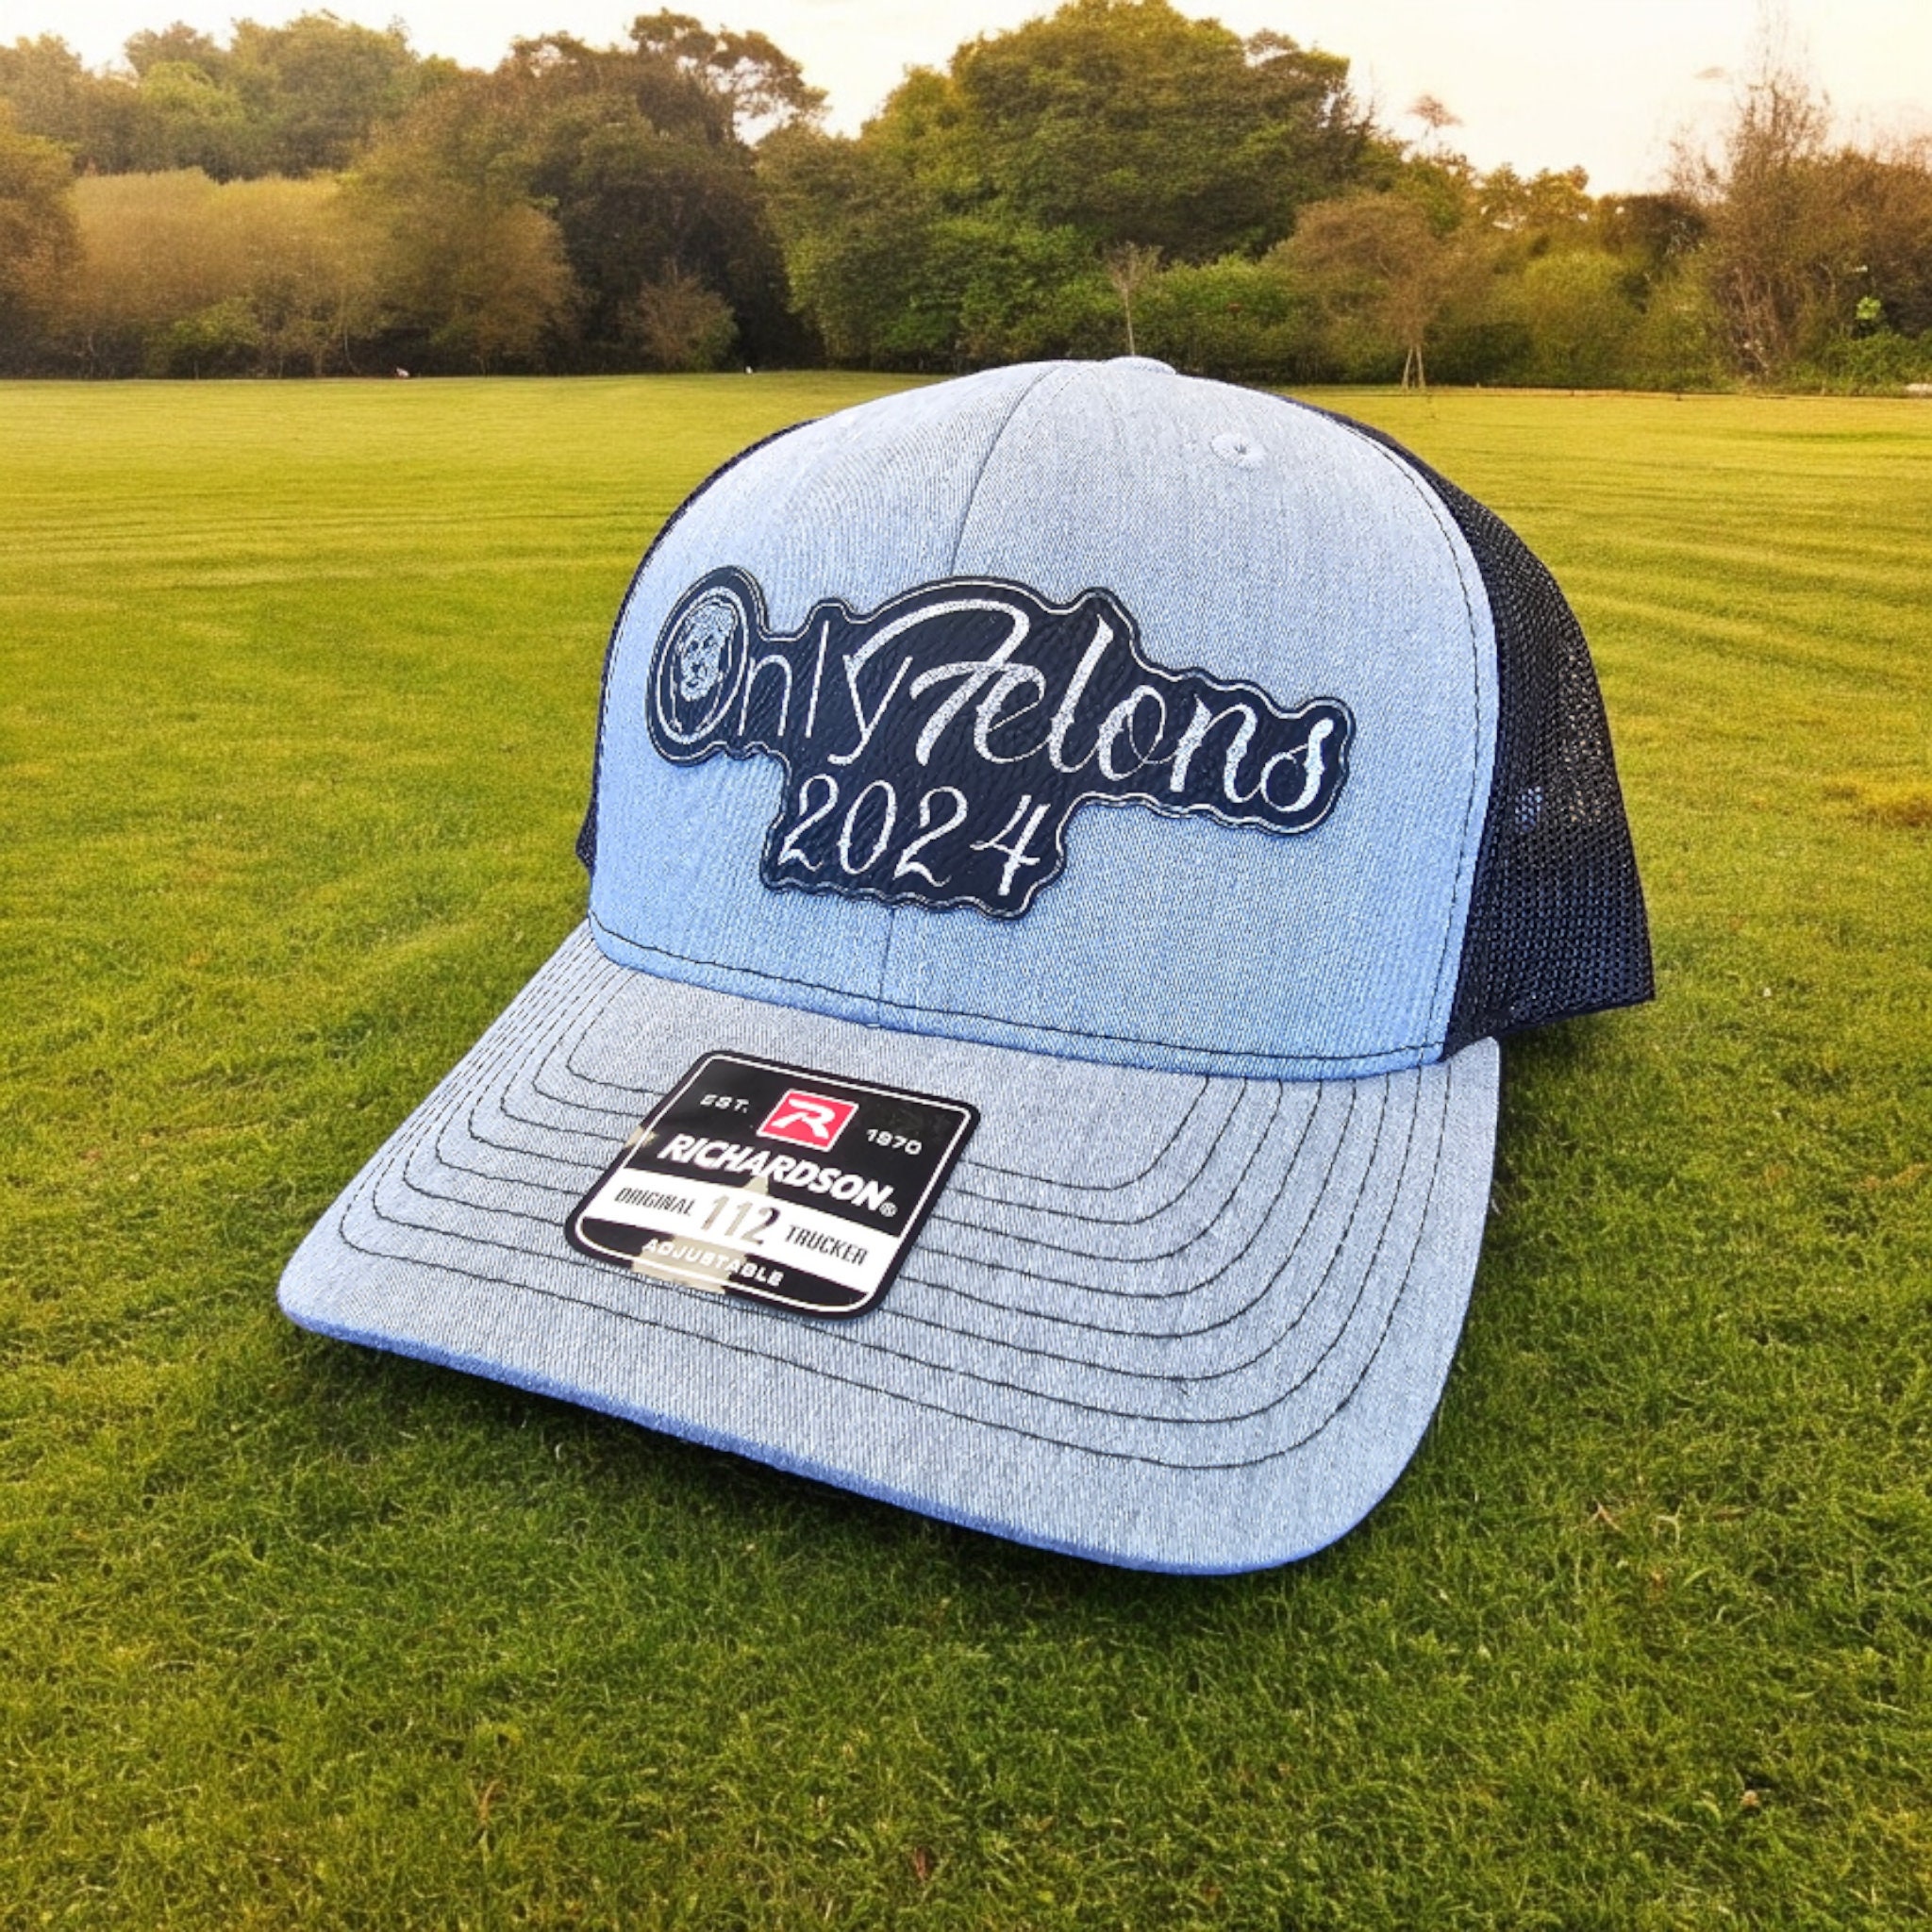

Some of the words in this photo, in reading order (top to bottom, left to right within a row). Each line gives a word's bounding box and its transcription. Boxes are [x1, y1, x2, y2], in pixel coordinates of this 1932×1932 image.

[777, 774, 1049, 896] 2024
[700, 1092, 751, 1114] EST.
[866, 1127, 924, 1157] 1970
[614, 1186, 696, 1216] ORIGINAL
[700, 1193, 782, 1246] 112
[785, 1224, 869, 1267] TRUCKER
[641, 1238, 784, 1288] ADJUSTABLE
